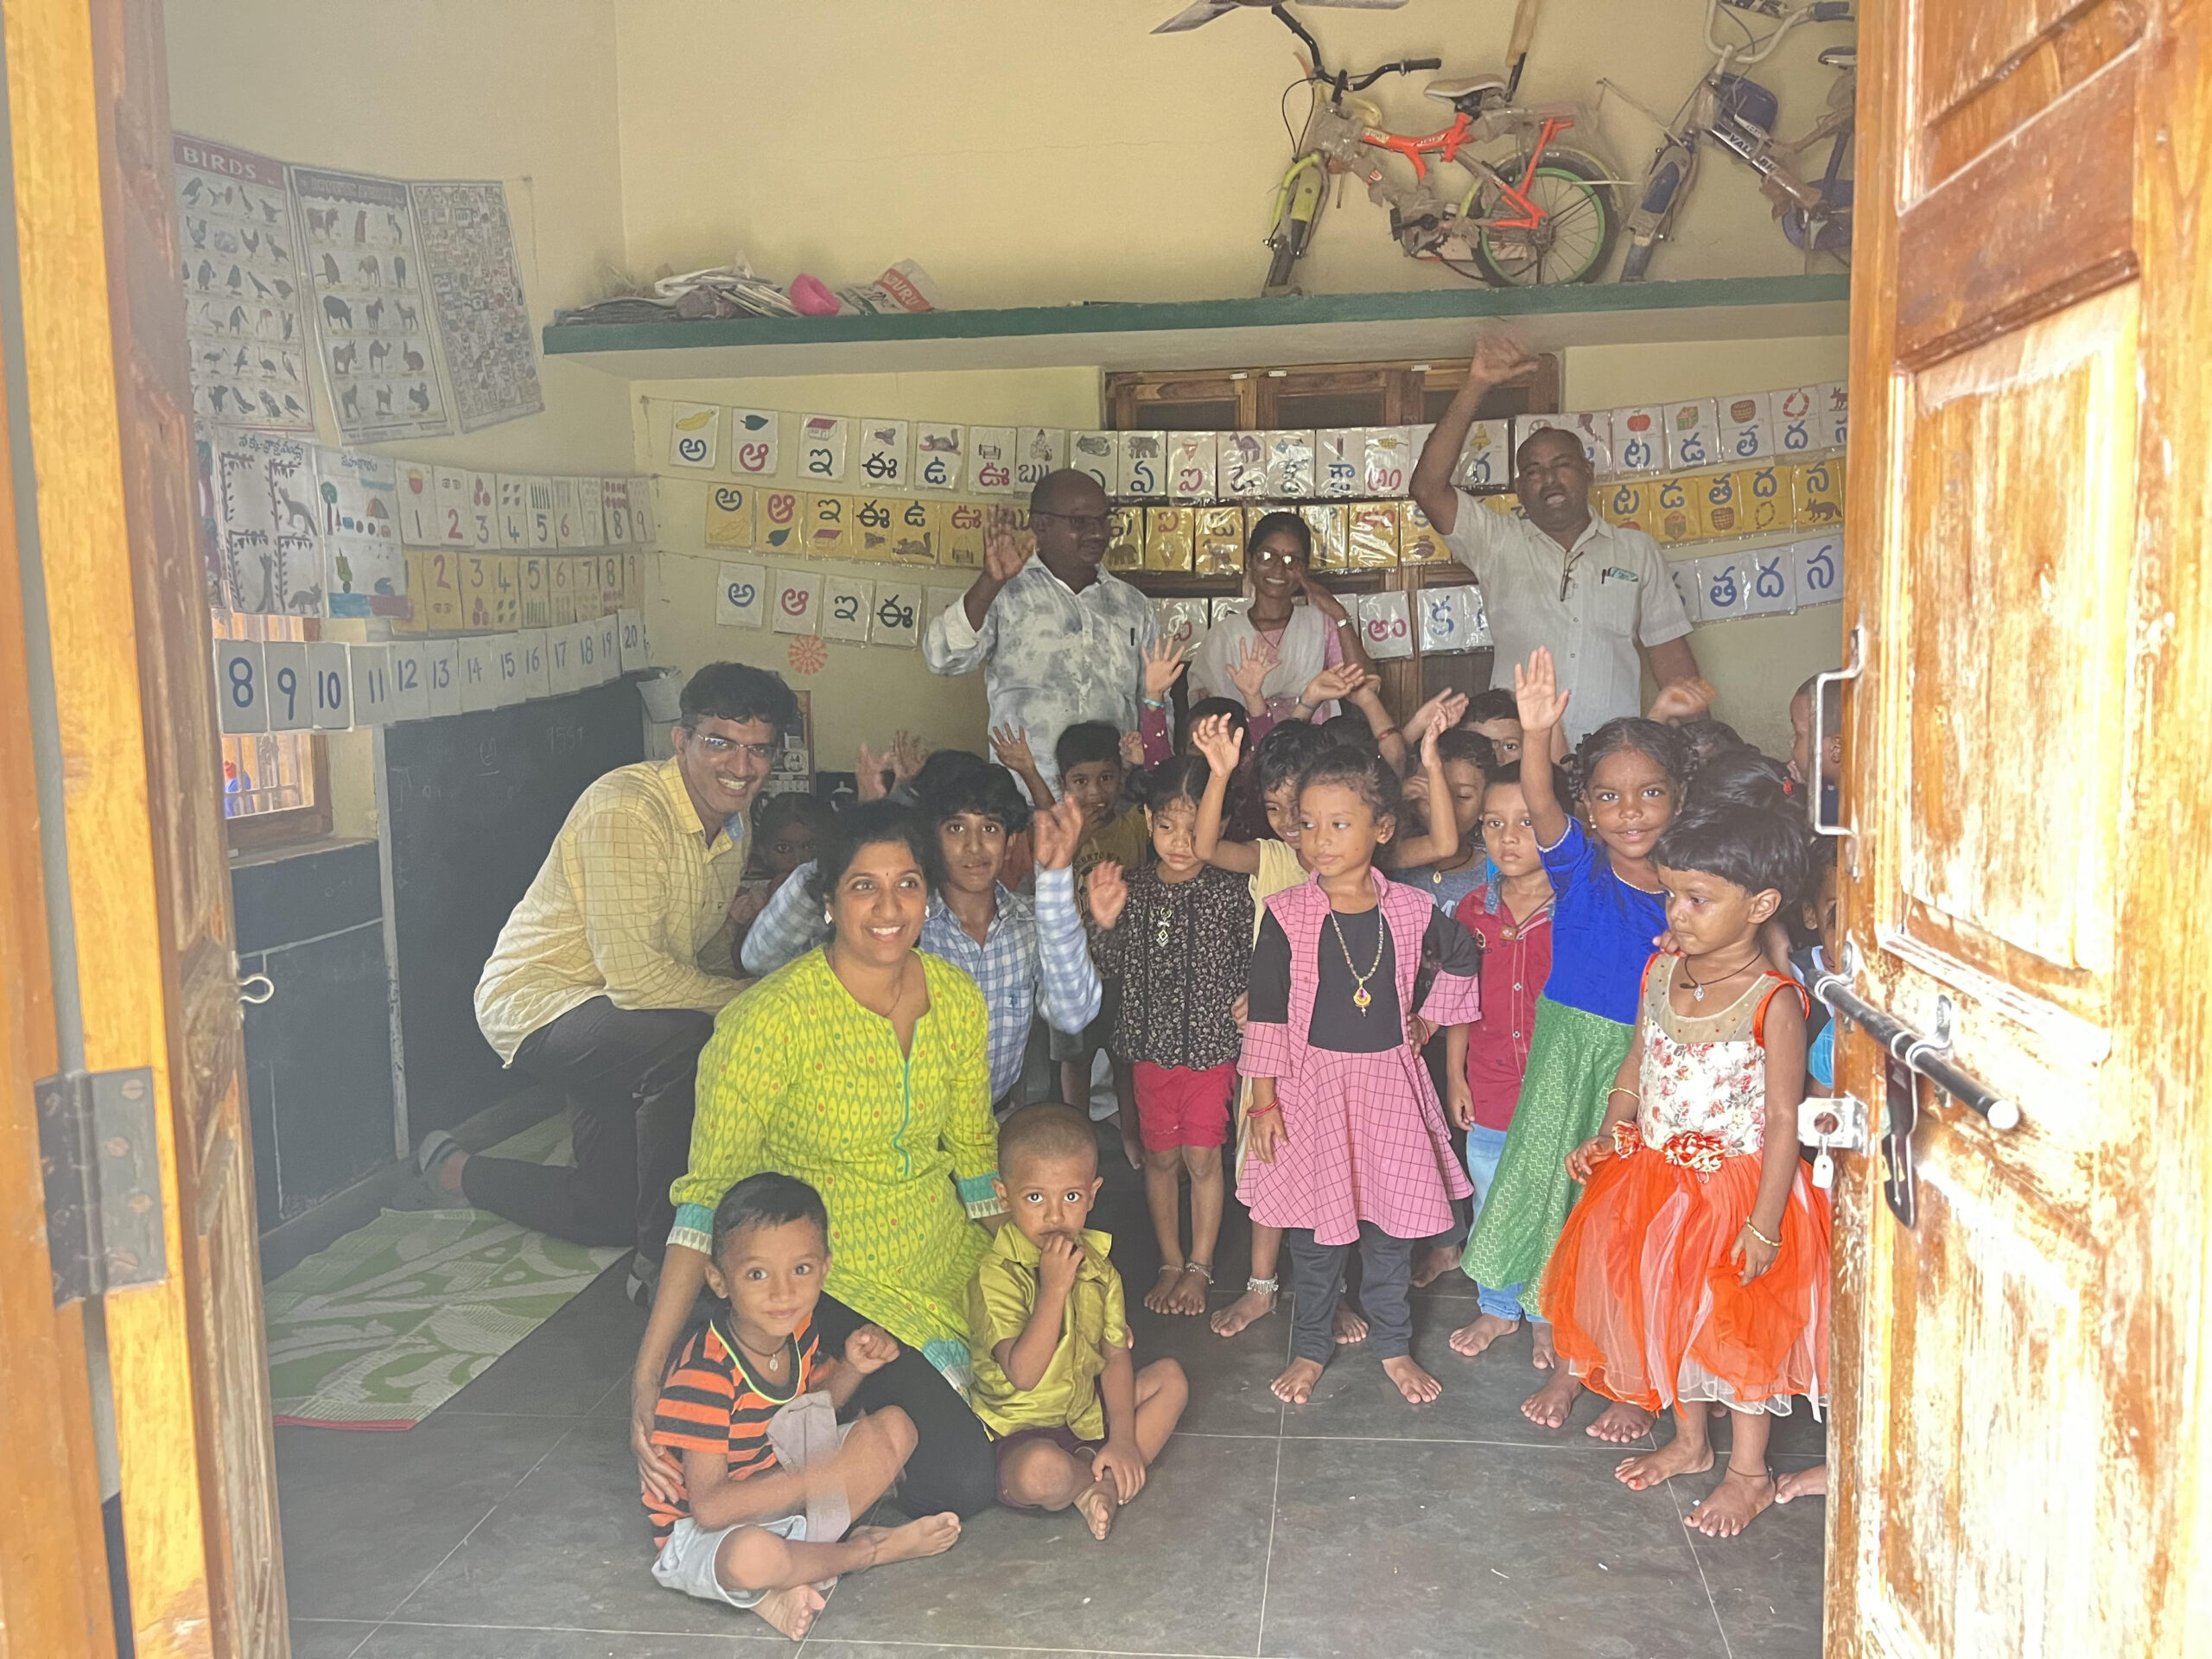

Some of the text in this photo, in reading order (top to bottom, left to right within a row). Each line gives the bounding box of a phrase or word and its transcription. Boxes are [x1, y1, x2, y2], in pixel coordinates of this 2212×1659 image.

[183, 146, 257, 179] BIRDS
[679, 437, 707, 462] అ
[739, 442, 769, 472] ఆ
[809, 448, 834, 476] ఇ
[861, 451, 897, 480] ఈ
[924, 456, 946, 486] ఉ
[979, 462, 1010, 486] ఊ
[1130, 461, 1154, 493] ఏ
[1179, 468, 1203, 492] ఐ
[1624, 439, 1650, 467] ట
[1680, 432, 1706, 463] డ
[1736, 424, 1759, 457] త
[1784, 420, 1808, 449] ద
[415, 509, 422, 539] 1
[448, 508, 463, 540] 2
[476, 515, 489, 543] 3
[507, 515, 519, 543] 4
[536, 513, 548, 543] 5
[561, 512, 570, 537] 6
[613, 510, 623, 539] 8
[636, 510, 647, 540] 9
[715, 488, 742, 512] అ
[766, 493, 795, 524] ఆ
[817, 499, 842, 524] ఇ
[856, 499, 890, 528] ఈ
[904, 500, 926, 528] ఉ
[951, 505, 982, 530] ఊ
[1158, 511, 1179, 533] ఐ
[1613, 484, 1640, 515] ట
[1660, 478, 1685, 509] డ
[1708, 473, 1733, 505] త
[1752, 466, 1777, 498] ద
[1806, 461, 1830, 494] న
[434, 554, 452, 590] 2
[470, 559, 484, 588] 3
[498, 562, 512, 592] 4
[527, 560, 541, 590] 5
[556, 562, 566, 588] 6
[582, 562, 593, 587] 7
[606, 558, 615, 587] 8
[628, 555, 636, 585] 9
[728, 582, 755, 608] అ
[780, 588, 809, 616] ఆ
[835, 594, 859, 623] ఇ
[876, 594, 913, 629] ఈ
[1368, 619, 1407, 642] అం
[1432, 594, 1454, 636] క
[1710, 566, 1738, 607] త
[1756, 556, 1784, 598] ద
[1806, 544, 1834, 590] న
[228, 625, 638, 721] 8 9 10 11 12 13 14 15 16 17 18 19 20
